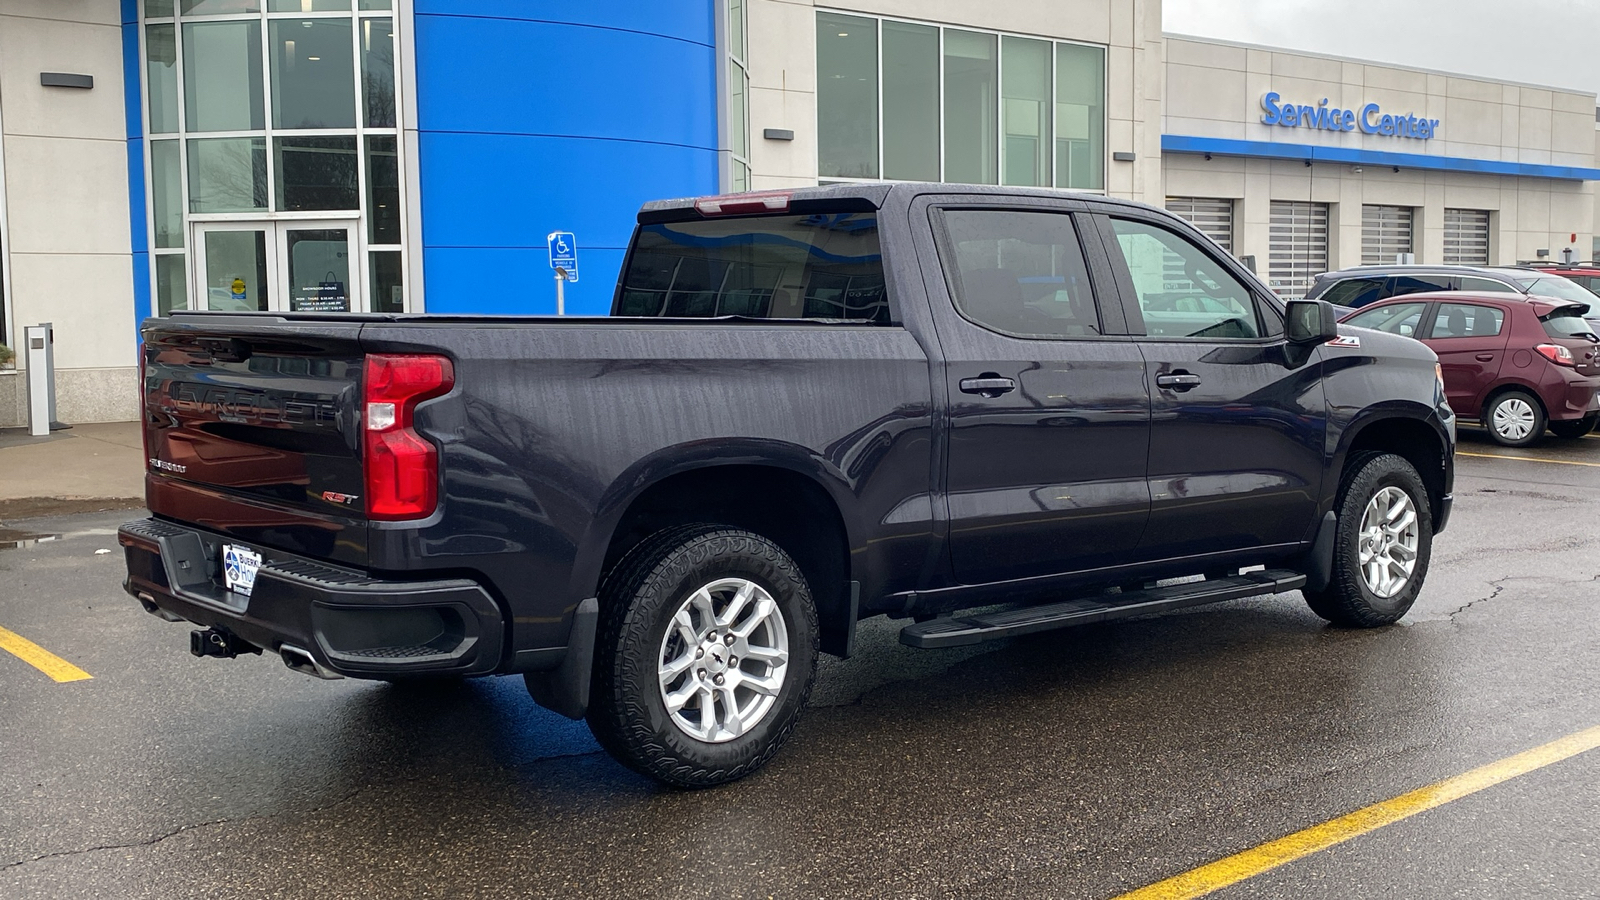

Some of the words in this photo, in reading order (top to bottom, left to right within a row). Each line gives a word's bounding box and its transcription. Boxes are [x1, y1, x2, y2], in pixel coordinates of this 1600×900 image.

[1260, 91, 1355, 132] Service
[1357, 102, 1439, 139] Center
[322, 491, 359, 504] RST
